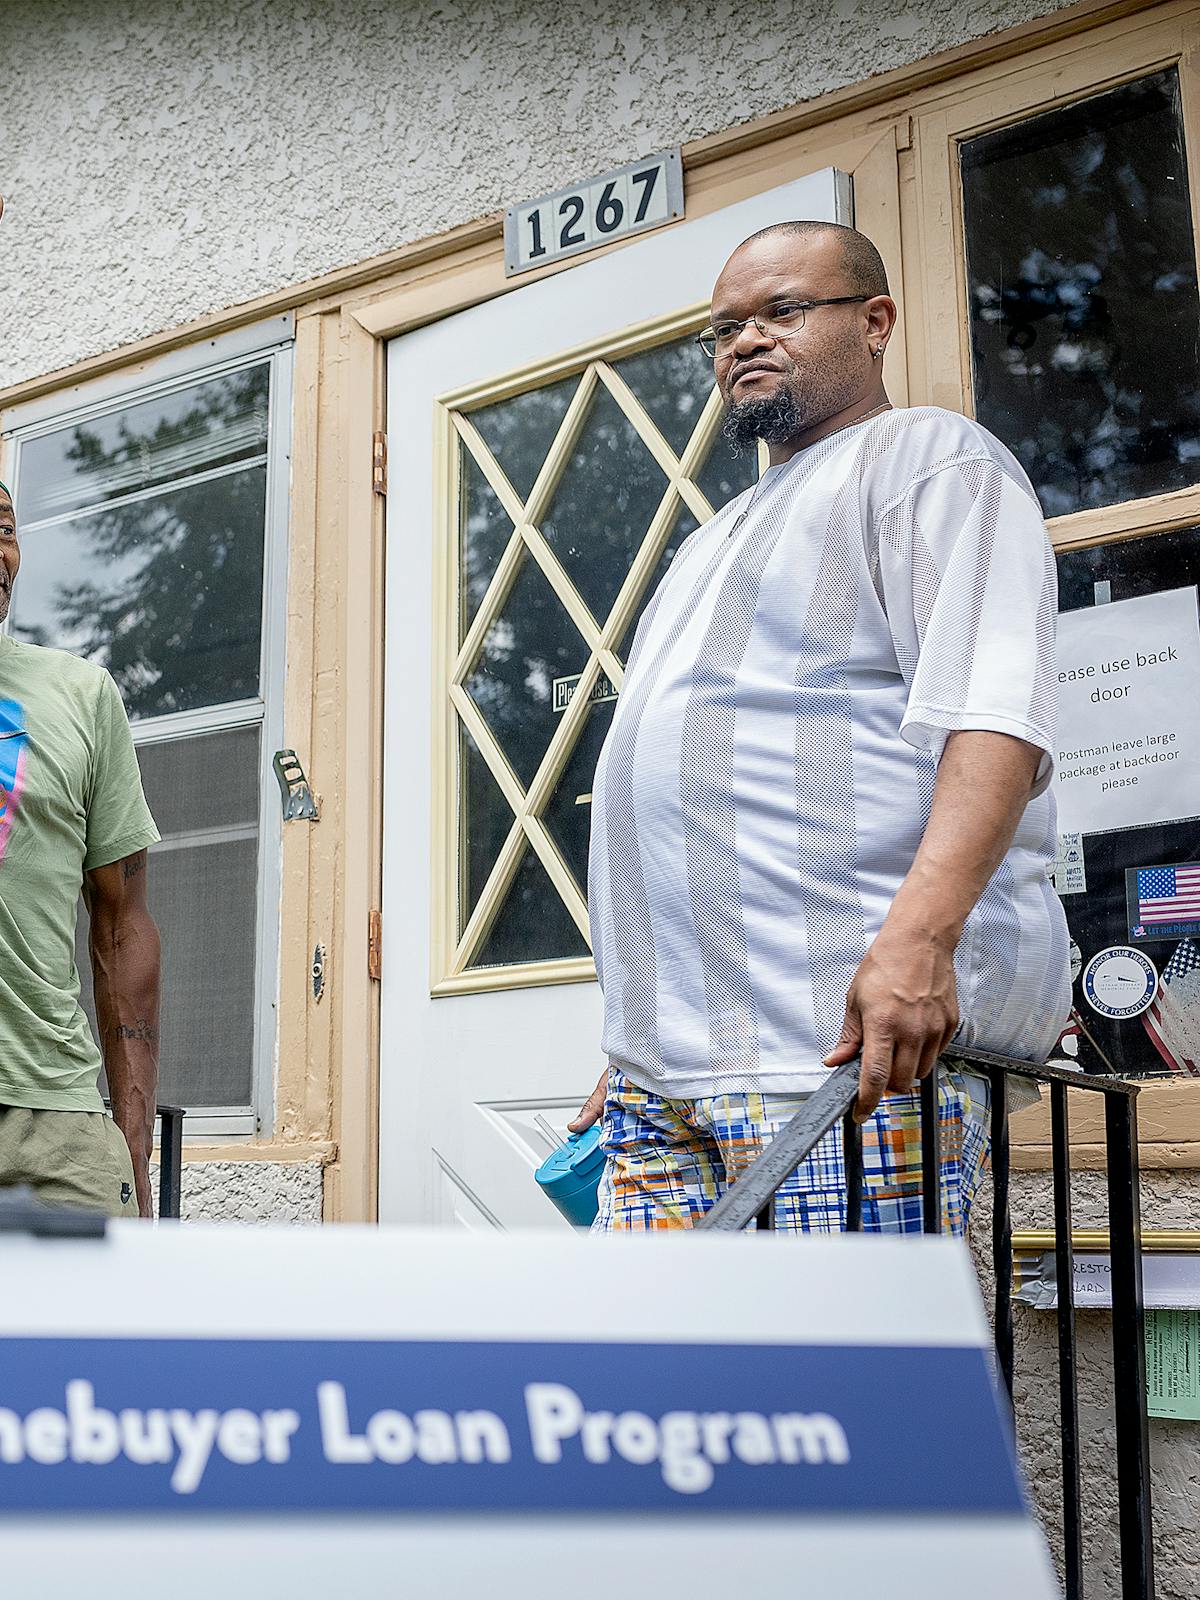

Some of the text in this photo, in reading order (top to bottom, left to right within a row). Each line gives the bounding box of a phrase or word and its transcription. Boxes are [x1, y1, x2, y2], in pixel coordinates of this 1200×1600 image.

[528, 165, 661, 259] 1267
[1057, 646, 1178, 683] ease use back
[558, 682, 576, 706] Ple
[1090, 685, 1131, 703] door
[1059, 732, 1176, 762] Postman leave large
[1059, 750, 1180, 782] package at backdoor
[1101, 776, 1139, 792] please
[1089, 952, 1112, 976] HONOR
[1130, 951, 1152, 975] HEROES
[1089, 992, 1152, 1016] NEVER FORGOTTEN
[1072, 1263, 1111, 1274] RESTO
[1073, 1282, 1106, 1293] LARD
[316, 1381, 512, 1466] Loan
[523, 1381, 851, 1495] Program
